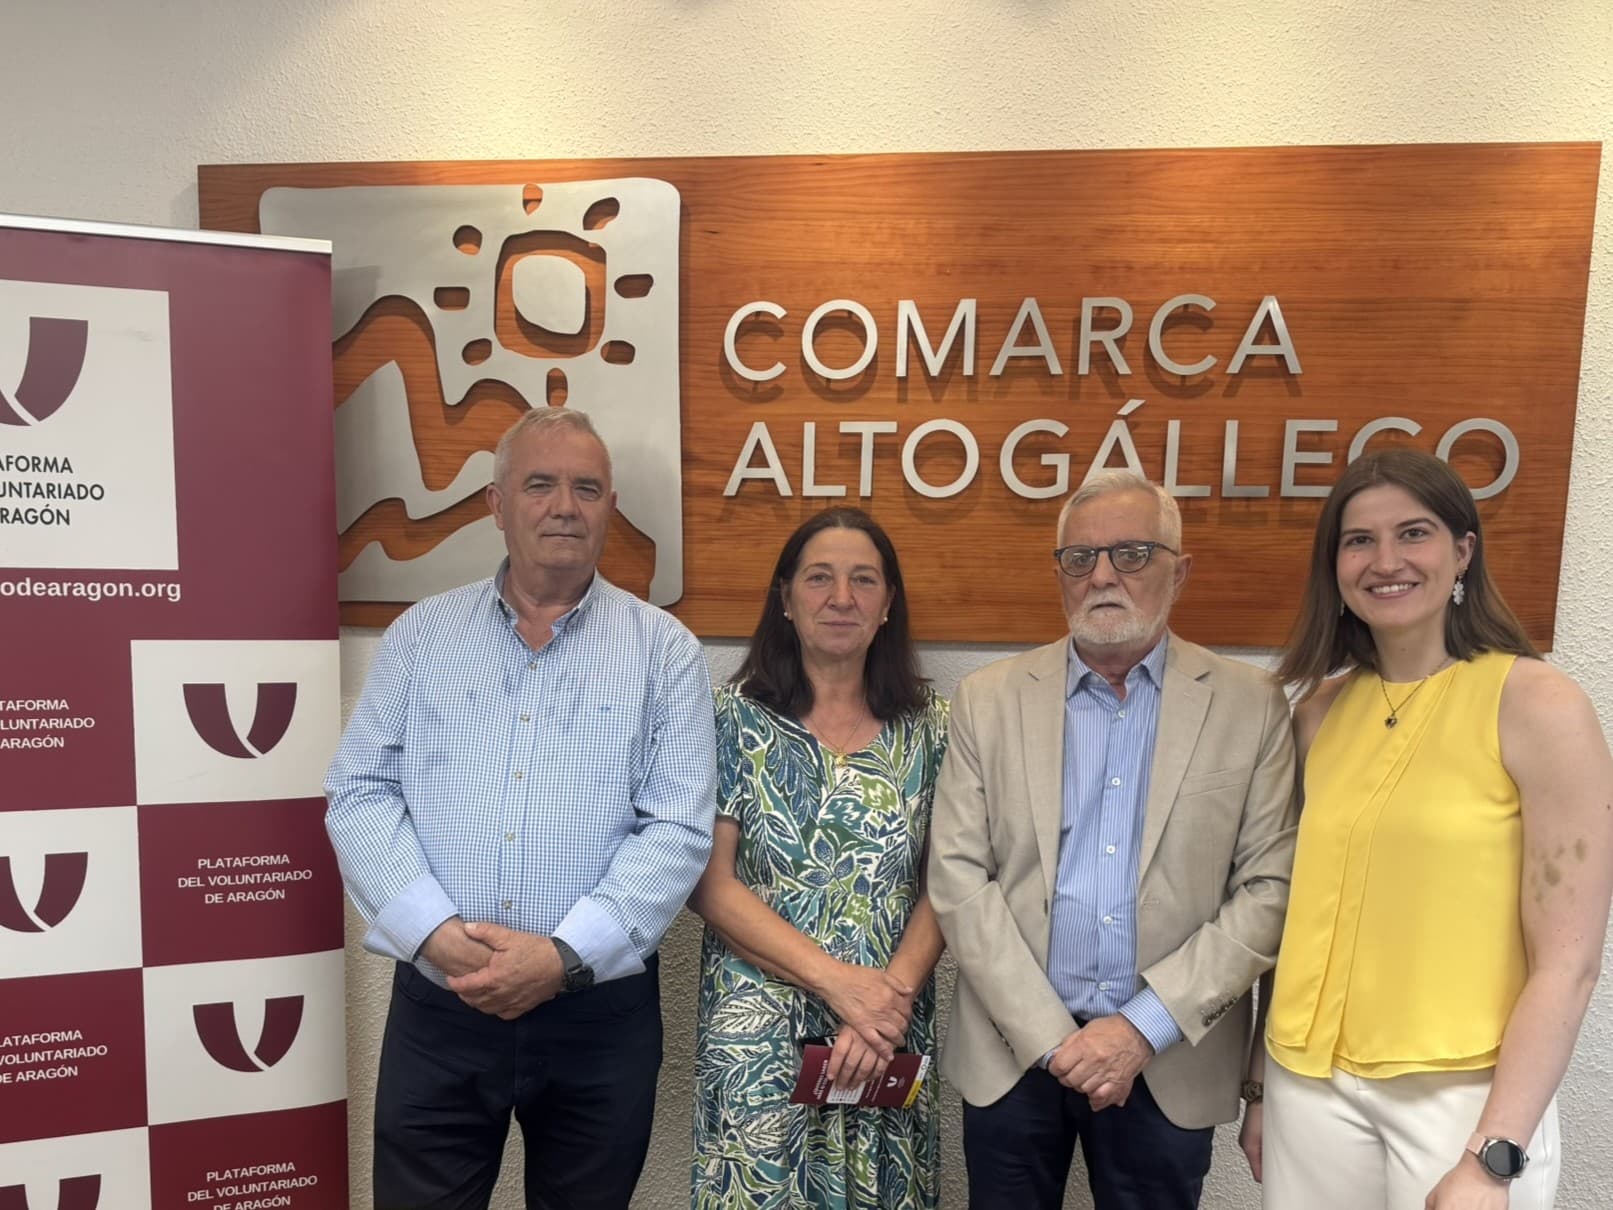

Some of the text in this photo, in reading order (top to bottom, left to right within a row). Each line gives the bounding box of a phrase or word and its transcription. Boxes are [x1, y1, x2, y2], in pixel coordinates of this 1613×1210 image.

[723, 294, 1303, 381] COMARCA
[723, 418, 979, 499] ALTO
[0, 504, 70, 525] RAGÓN
[0, 577, 181, 602] odearagon.org
[0, 717, 96, 730] LUNTARIADO
[0, 734, 65, 749] ARAGÓN
[197, 853, 290, 870] PLATAFORMA
[178, 869, 313, 888] DEL VOLUNTARIADO
[204, 887, 286, 904] DE ARAGÓN
[0, 1064, 79, 1084] E ARAGÓN
[206, 1162, 296, 1183] PLATAFORMA
[187, 1175, 318, 1202] DEL VOLUNTARIADO
[235, 1194, 291, 1210] ARAGÓN
